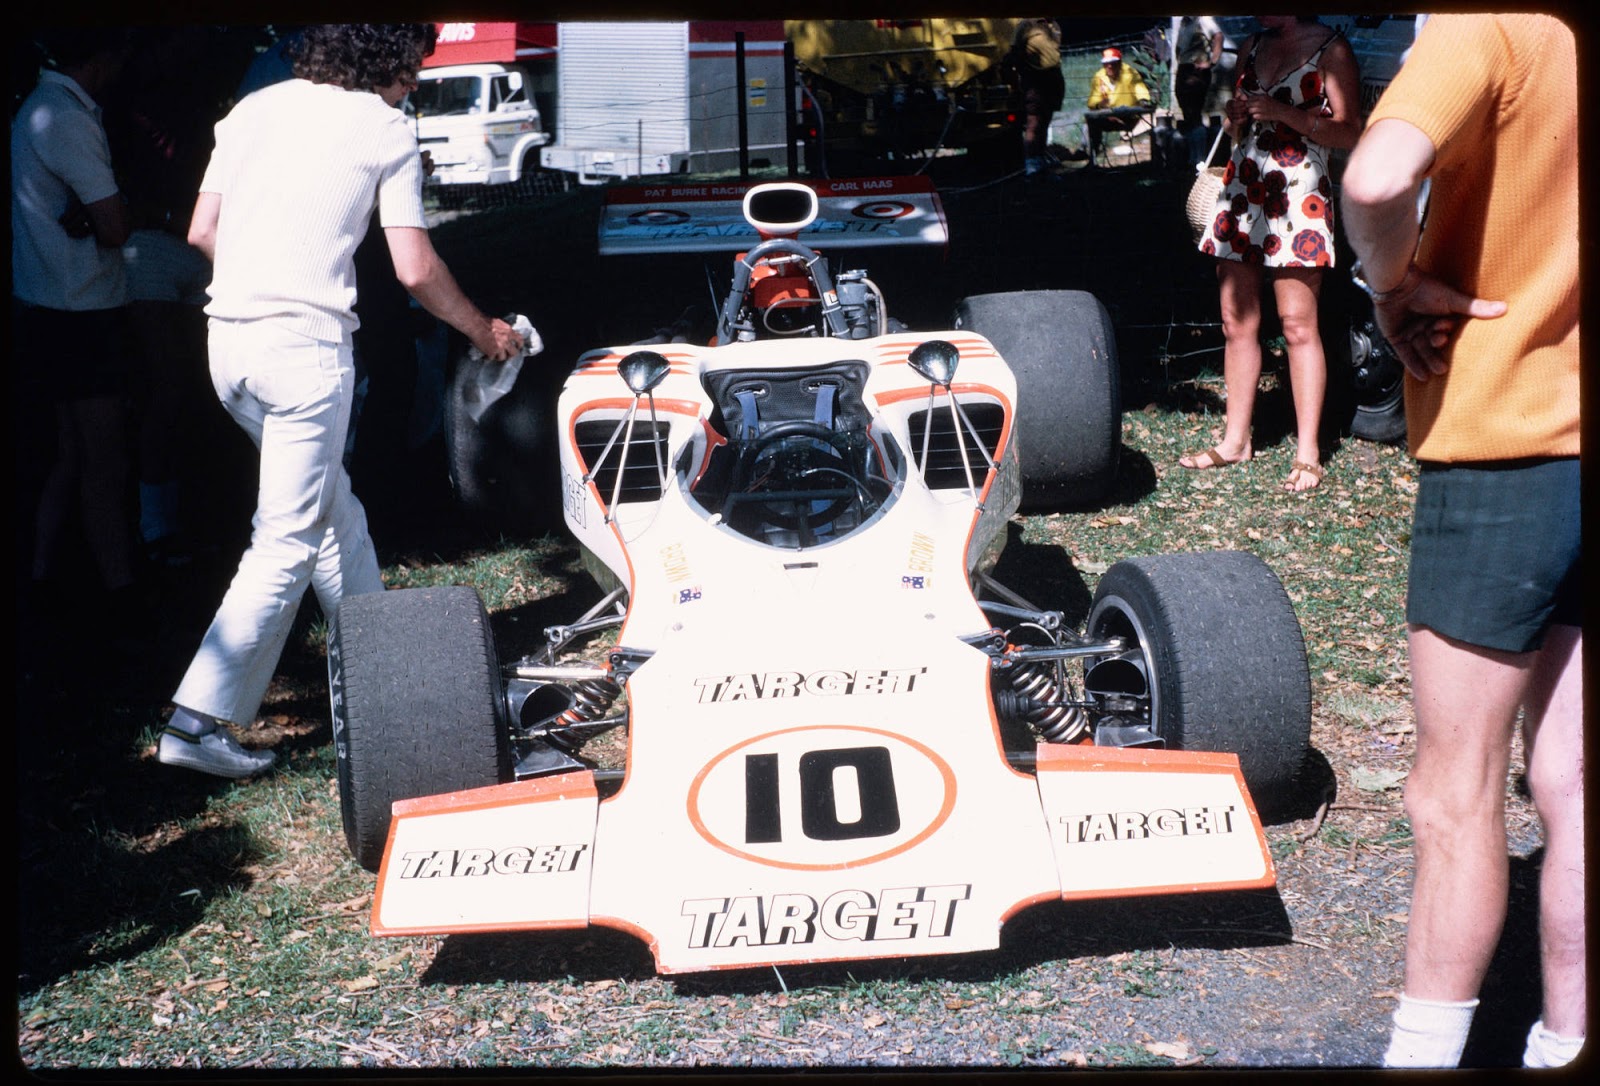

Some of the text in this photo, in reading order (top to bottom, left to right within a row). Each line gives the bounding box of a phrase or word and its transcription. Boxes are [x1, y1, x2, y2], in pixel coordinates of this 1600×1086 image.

[644, 189, 667, 198] PAT
[671, 187, 707, 197] BURKE
[830, 180, 894, 192] CARL HAAS
[908, 530, 936, 573] BROWN
[693, 666, 928, 704] TARGET
[745, 746, 901, 844] 10
[1059, 805, 1235, 844] TARGET
[400, 844, 588, 879] TARGET
[680, 884, 973, 949] TARGET
